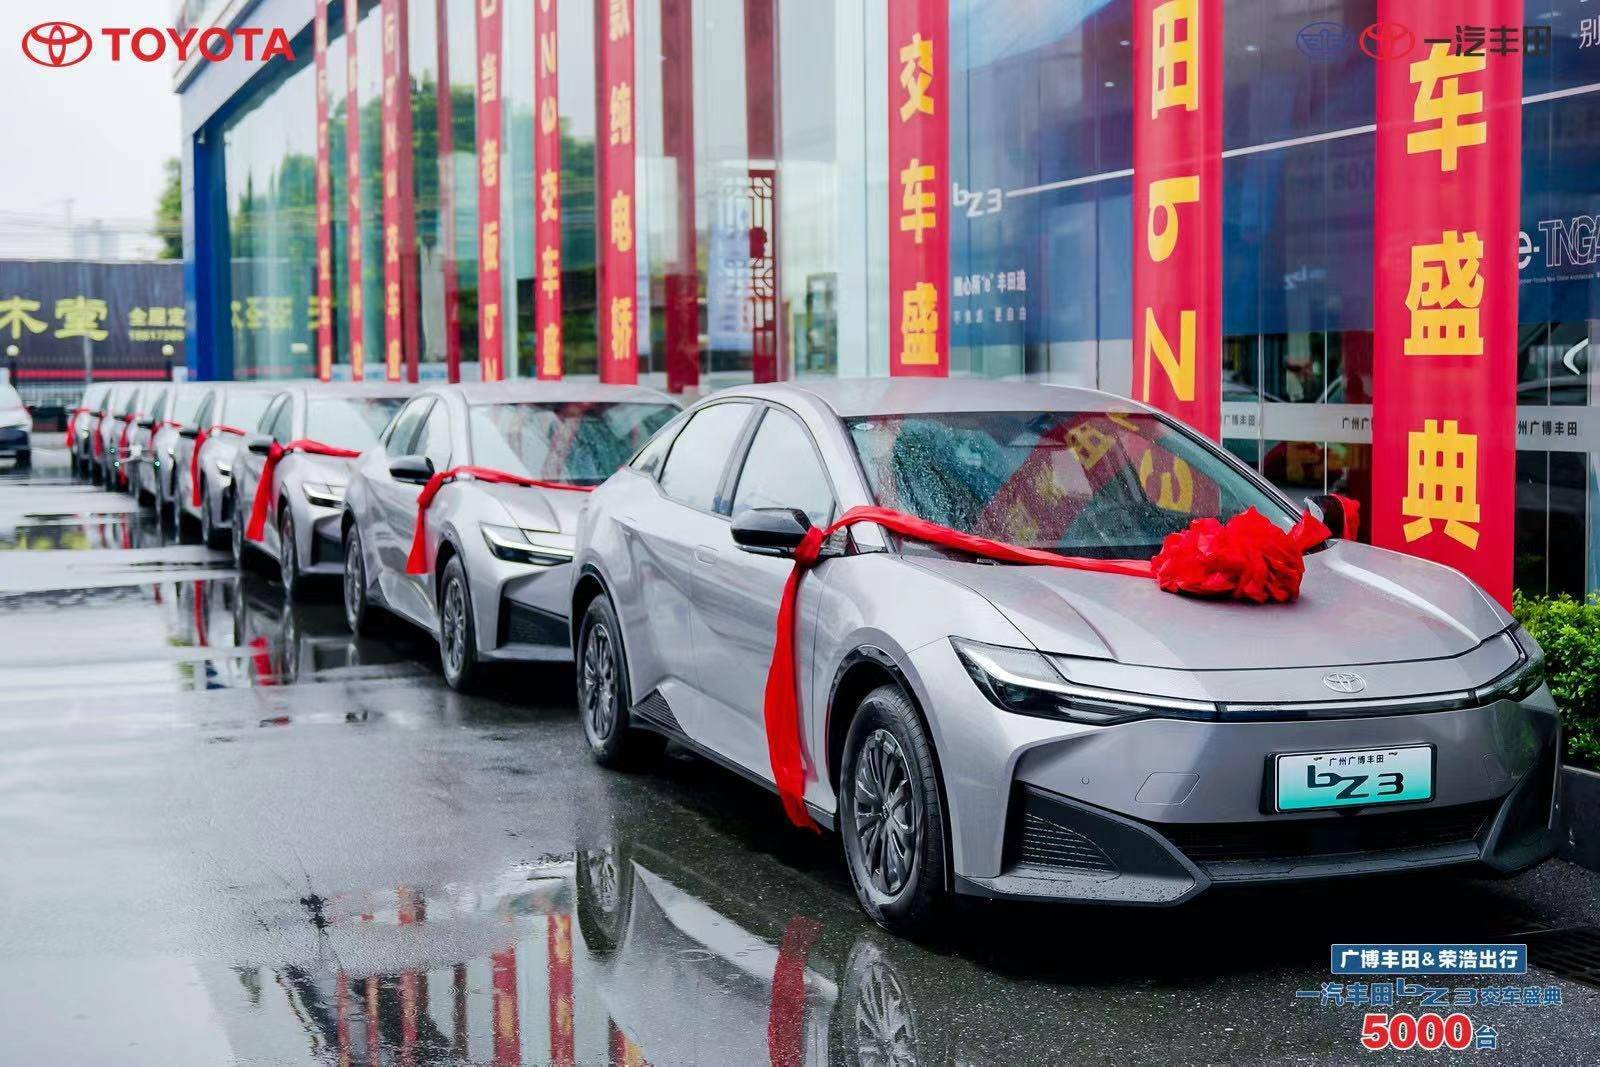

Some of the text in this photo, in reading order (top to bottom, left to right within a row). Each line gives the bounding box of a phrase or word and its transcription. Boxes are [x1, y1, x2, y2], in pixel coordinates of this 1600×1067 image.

[900, 32, 939, 365] 交车盛
[1402, 42, 1488, 551] 车盛典
[1329, 754, 1384, 766] 广州广博丰田
